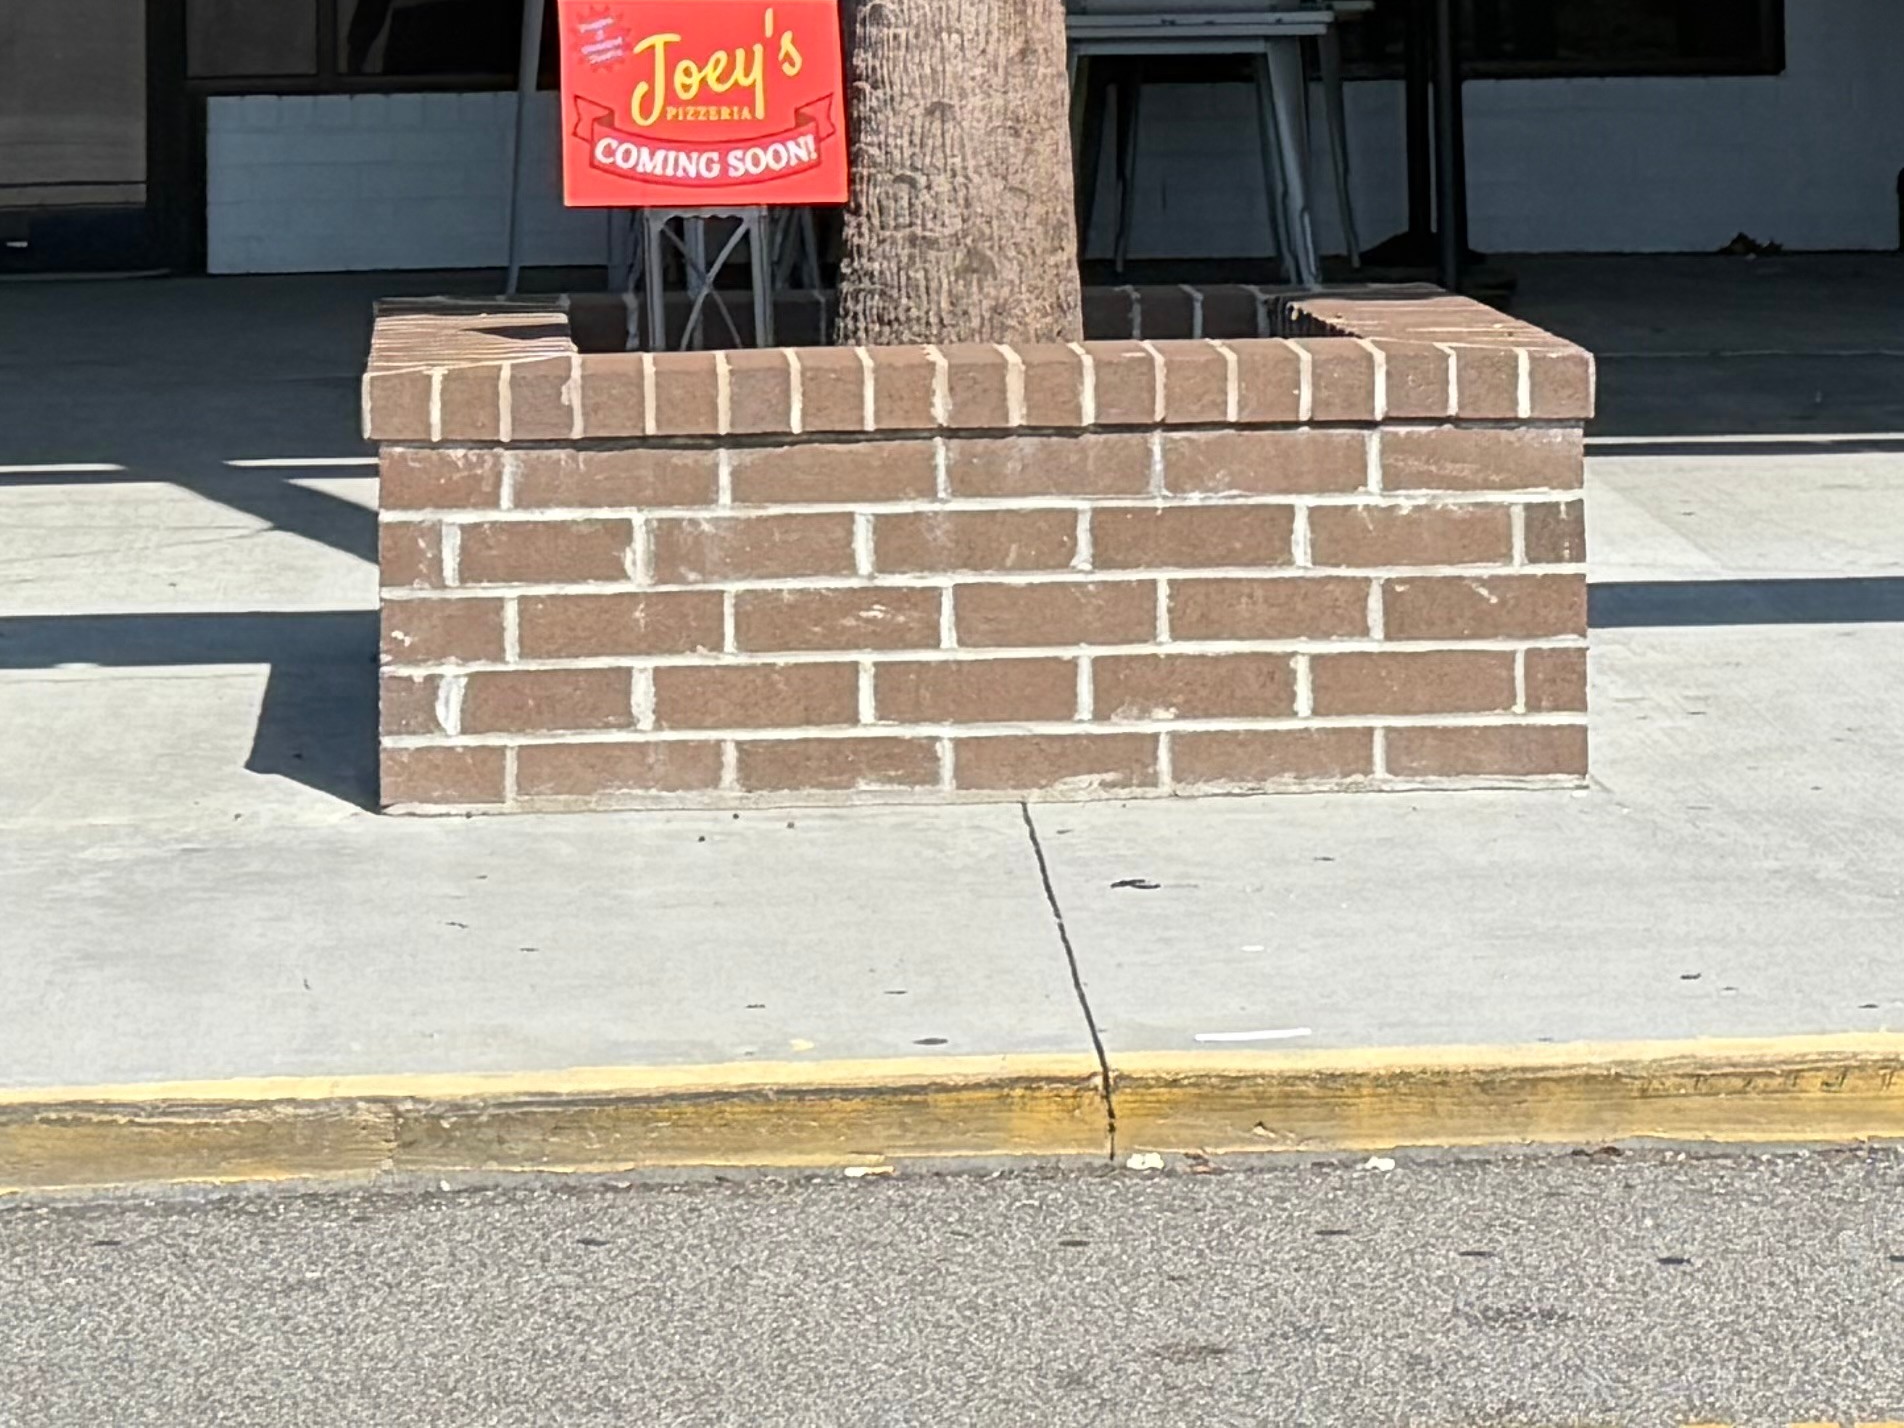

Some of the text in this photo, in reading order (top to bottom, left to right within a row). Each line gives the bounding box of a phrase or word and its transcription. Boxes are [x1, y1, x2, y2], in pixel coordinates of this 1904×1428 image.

[631, 7, 802, 126] Joey's
[666, 105, 752, 121] PIZZERIA
[594, 134, 818, 179] COMING SOON!
